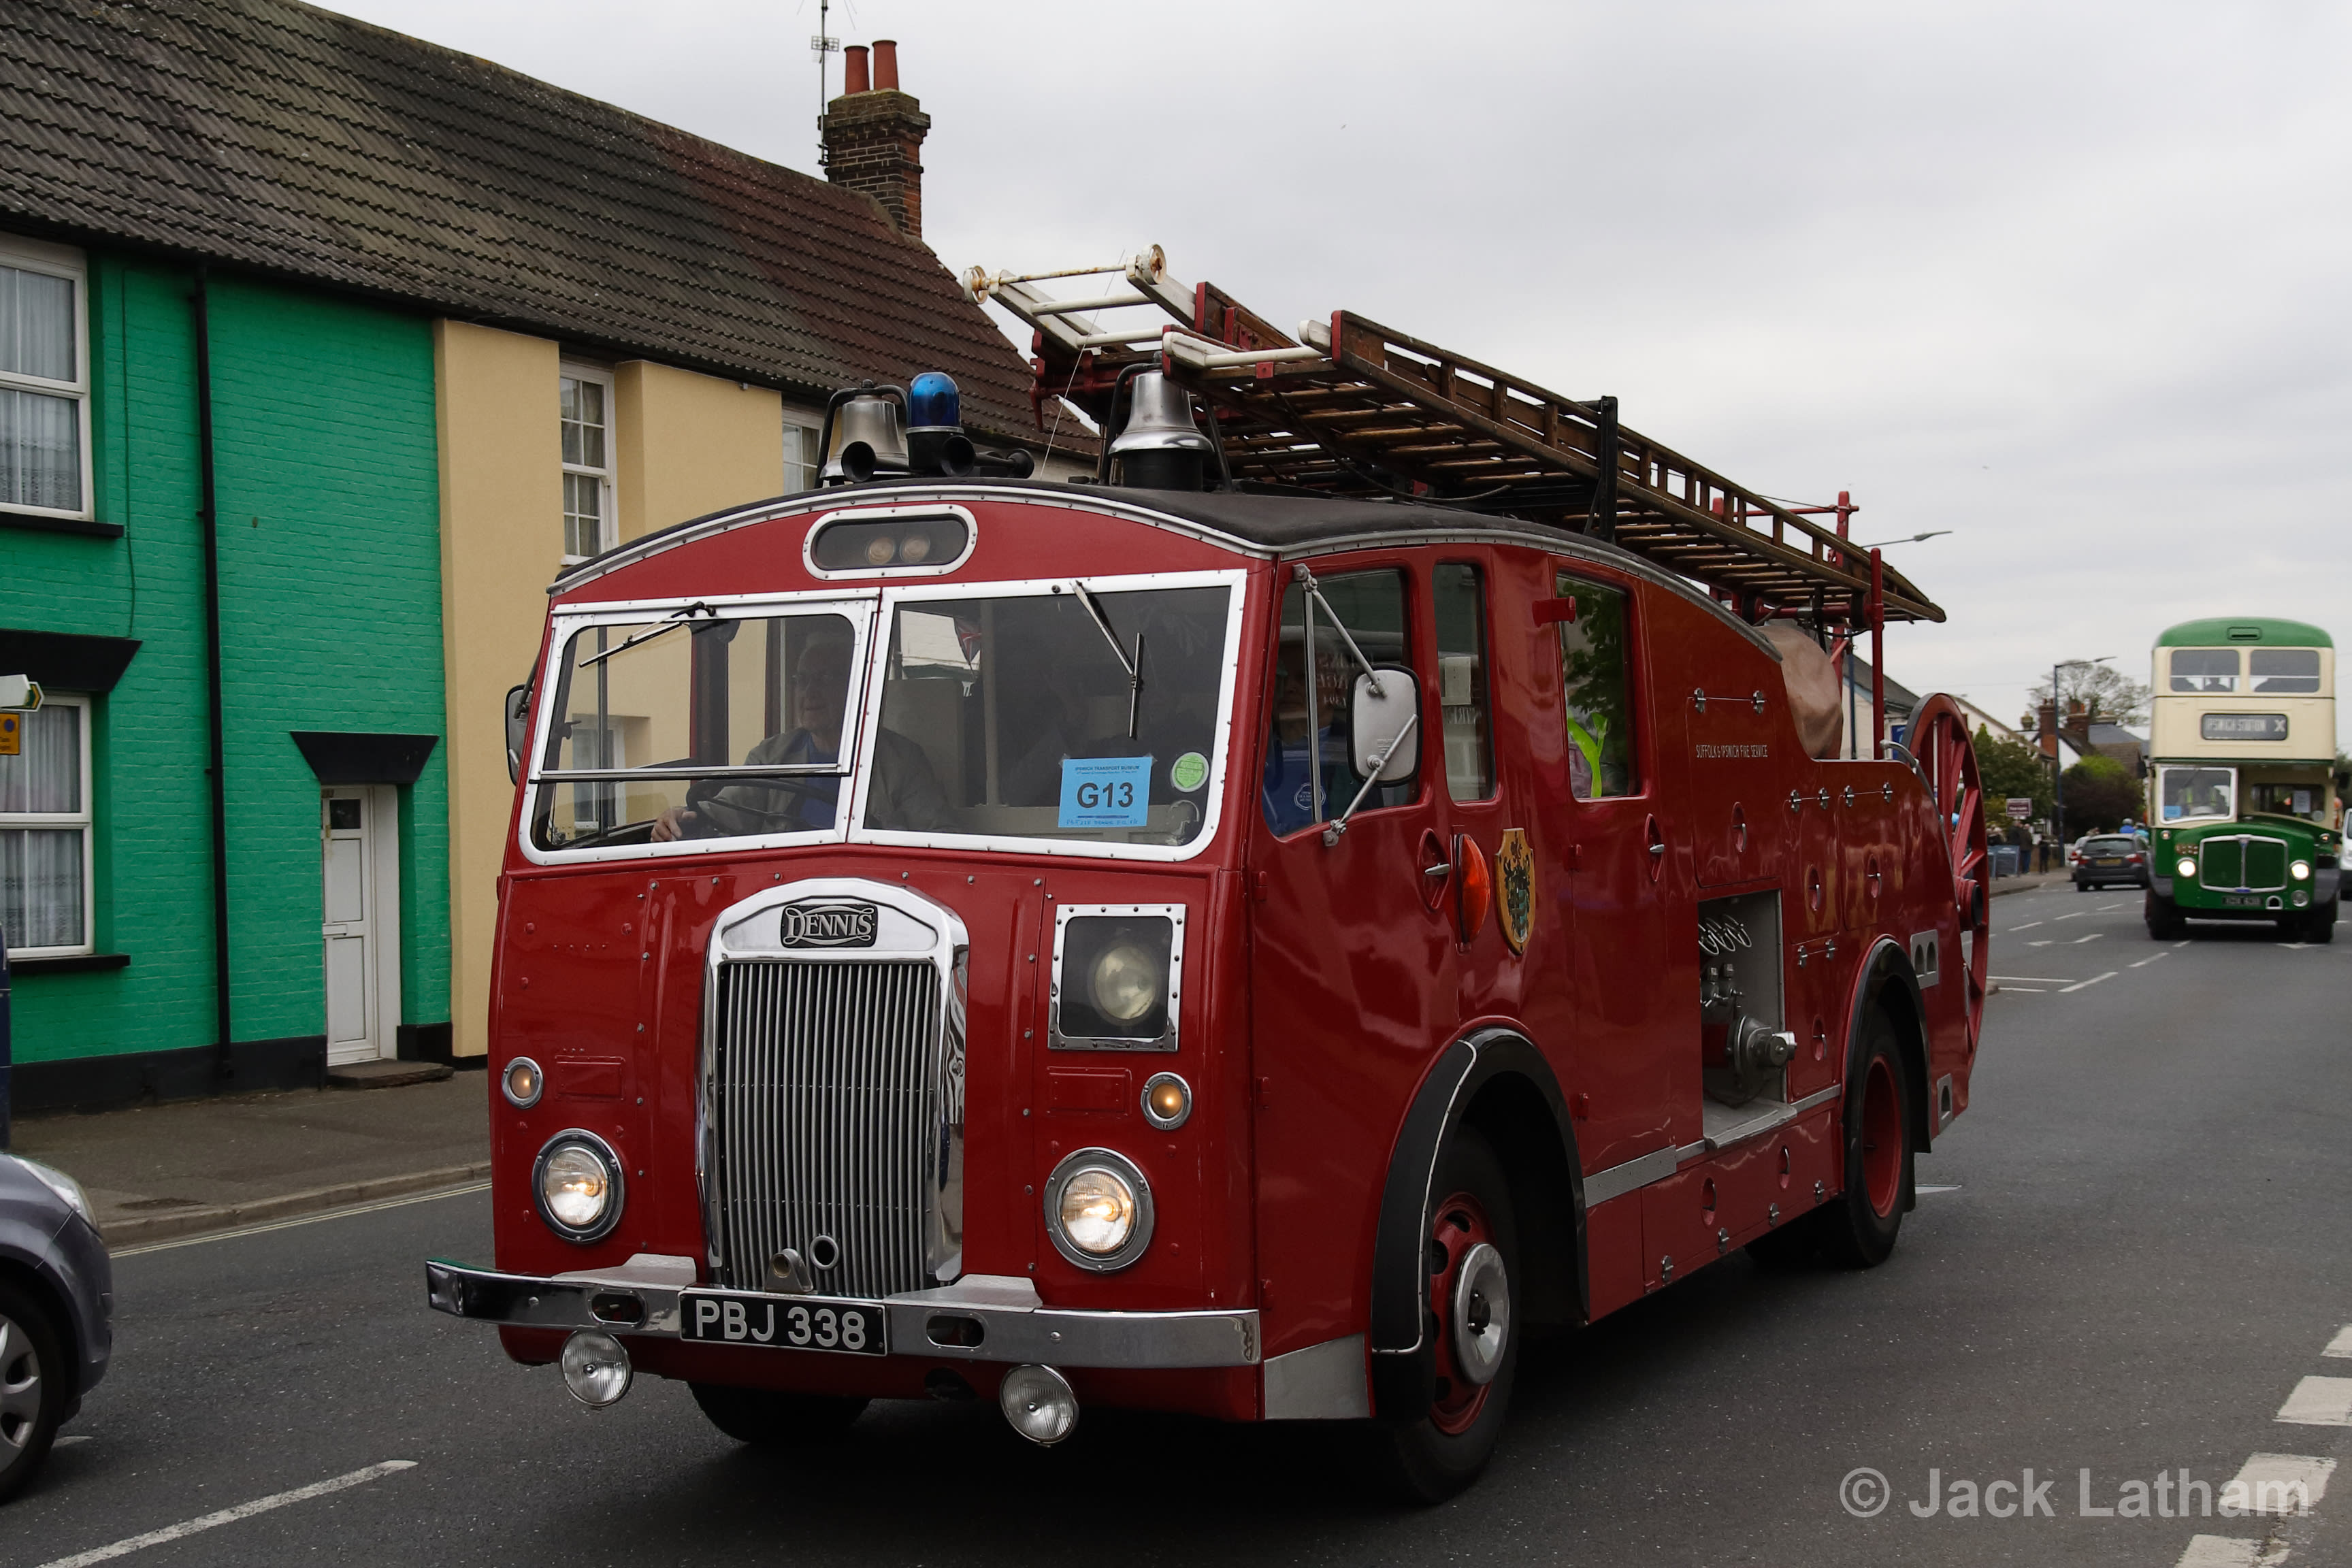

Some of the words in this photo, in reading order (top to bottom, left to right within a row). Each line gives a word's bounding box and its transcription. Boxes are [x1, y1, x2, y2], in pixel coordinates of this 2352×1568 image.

[2274, 719, 2285, 732] X
[1696, 745, 1717, 757] SUFFOLK
[1720, 745, 1740, 757] IPSWICH
[1740, 745, 1750, 757] FIRE
[1750, 745, 1768, 757] SERVICE
[1077, 782, 1133, 808] G13
[784, 909, 873, 941] DENNIS
[696, 1299, 774, 1342] PBJ
[787, 1306, 866, 1350] 338
